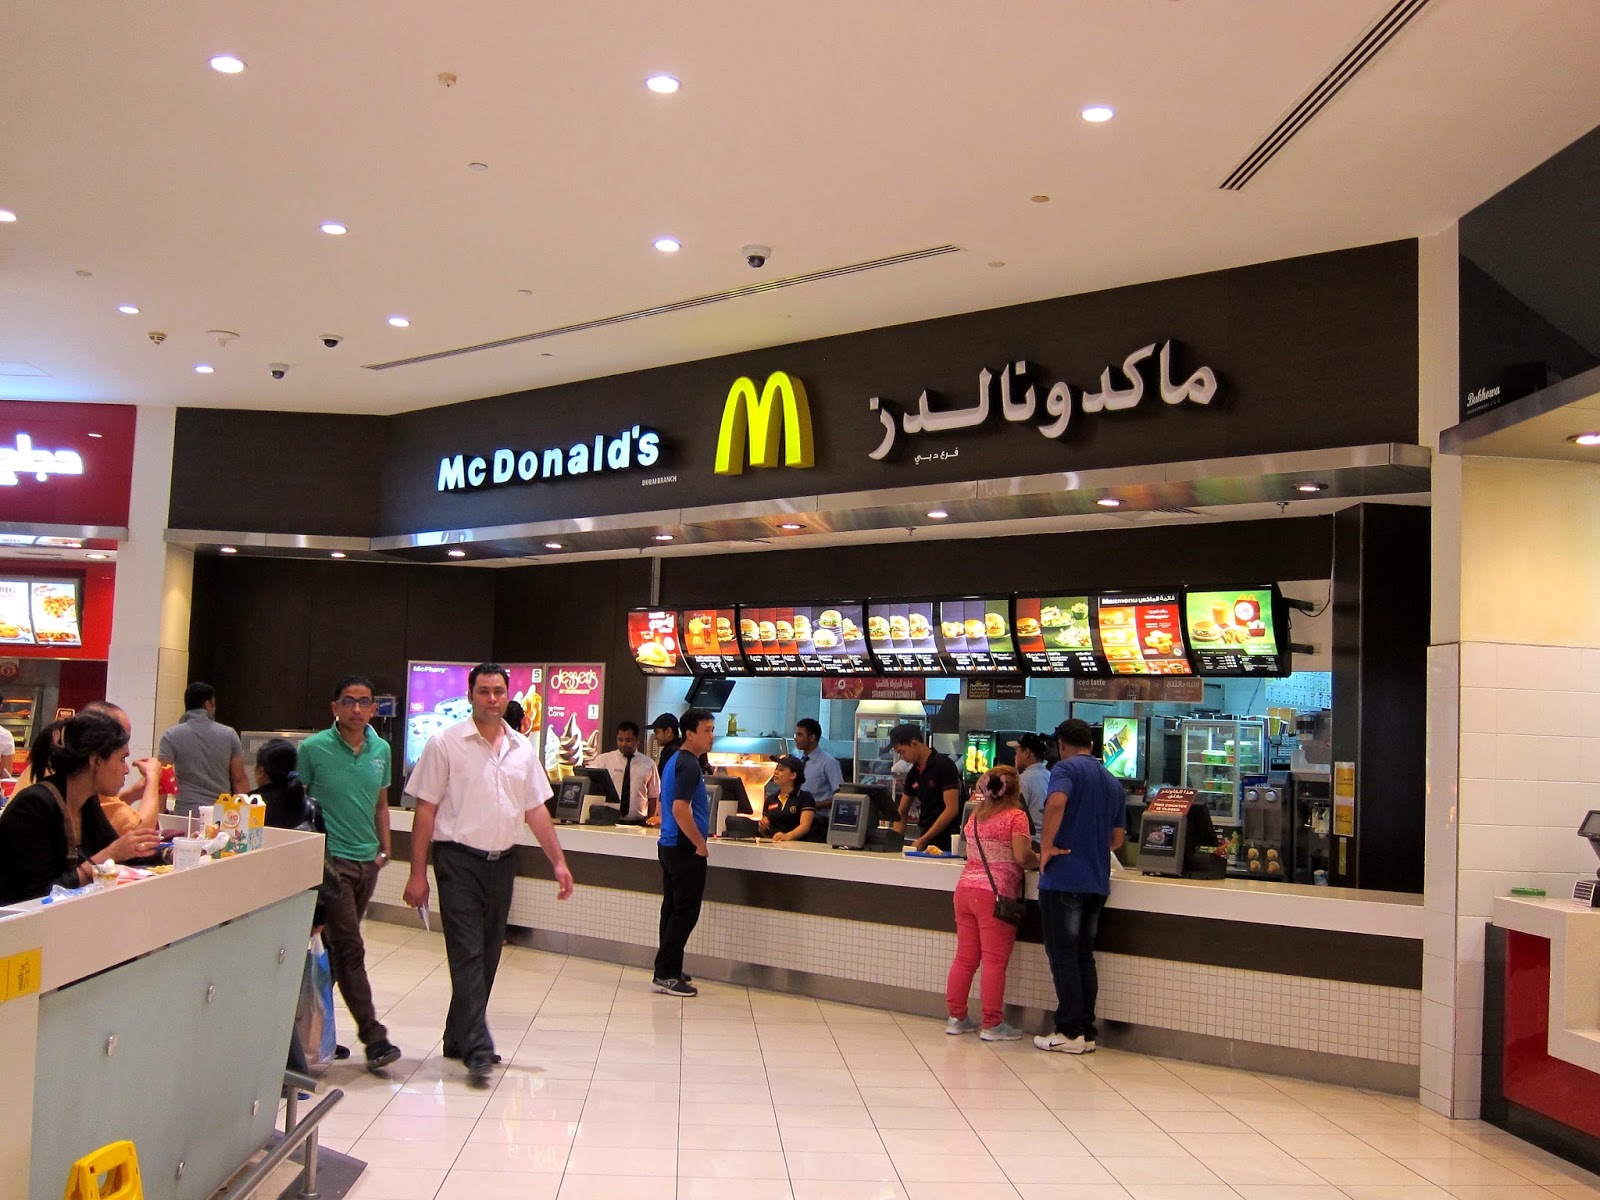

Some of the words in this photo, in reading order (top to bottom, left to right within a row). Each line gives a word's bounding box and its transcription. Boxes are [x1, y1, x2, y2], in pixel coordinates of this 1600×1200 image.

[868, 340, 1219, 461] ماكدونالدز
[533, 670, 540, 678] 5
[550, 669, 599, 690] desserts
[548, 710, 565, 718] Cone
[591, 706, 595, 715] 1
